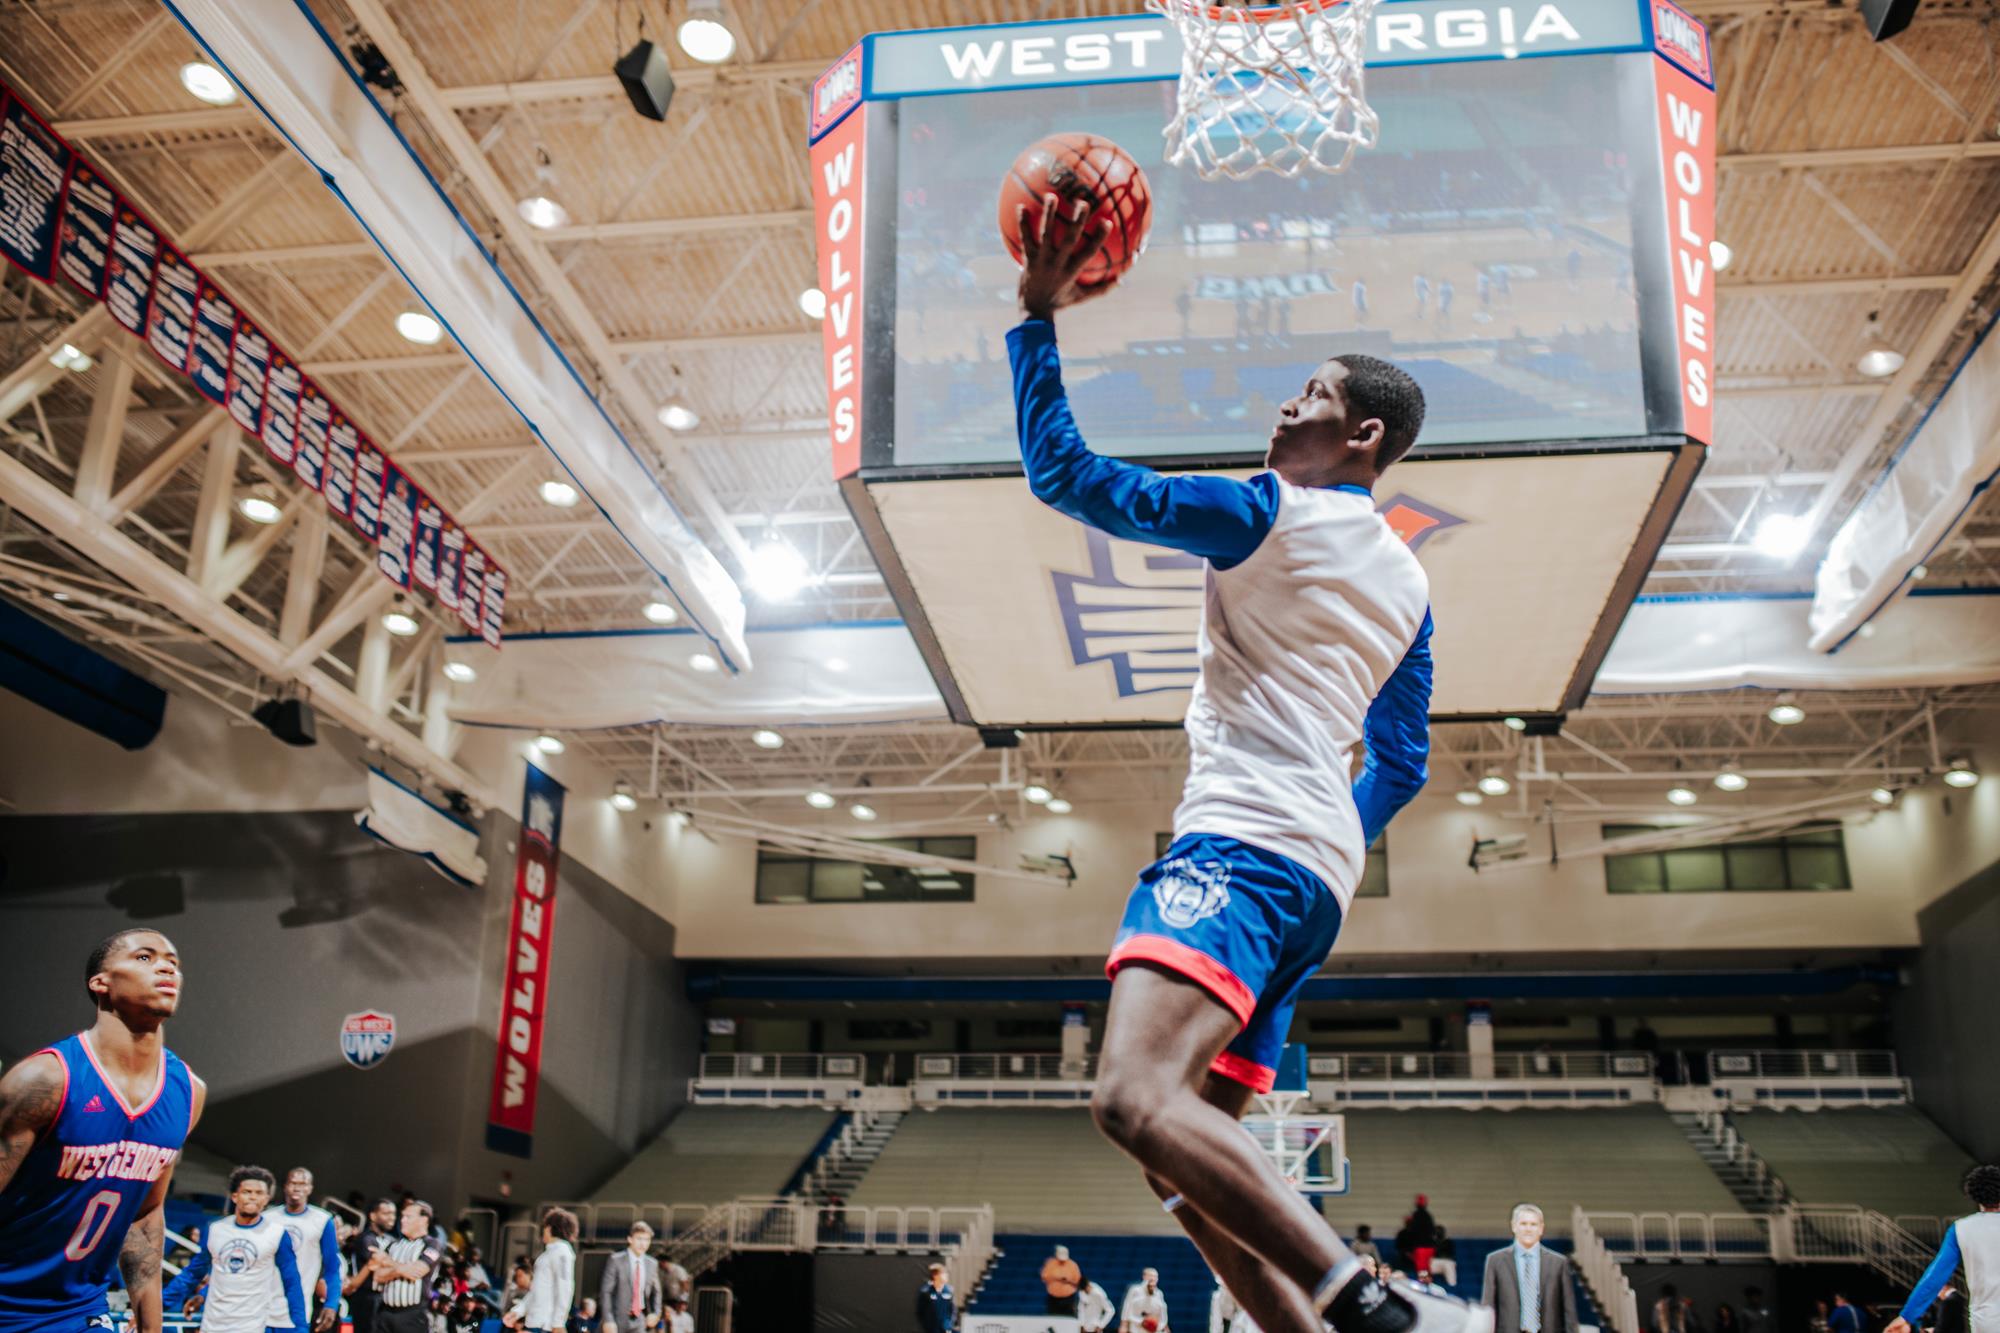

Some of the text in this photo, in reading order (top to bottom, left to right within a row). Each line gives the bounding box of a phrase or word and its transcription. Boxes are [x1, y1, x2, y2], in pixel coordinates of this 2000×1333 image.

[940, 28, 1163, 79] WEST
[823, 142, 855, 444] WOLVES
[1665, 92, 1710, 408] WOLVES
[503, 859, 547, 1108] WOLVES
[57, 1142, 118, 1181] WEST
[64, 1189, 121, 1262] 0
